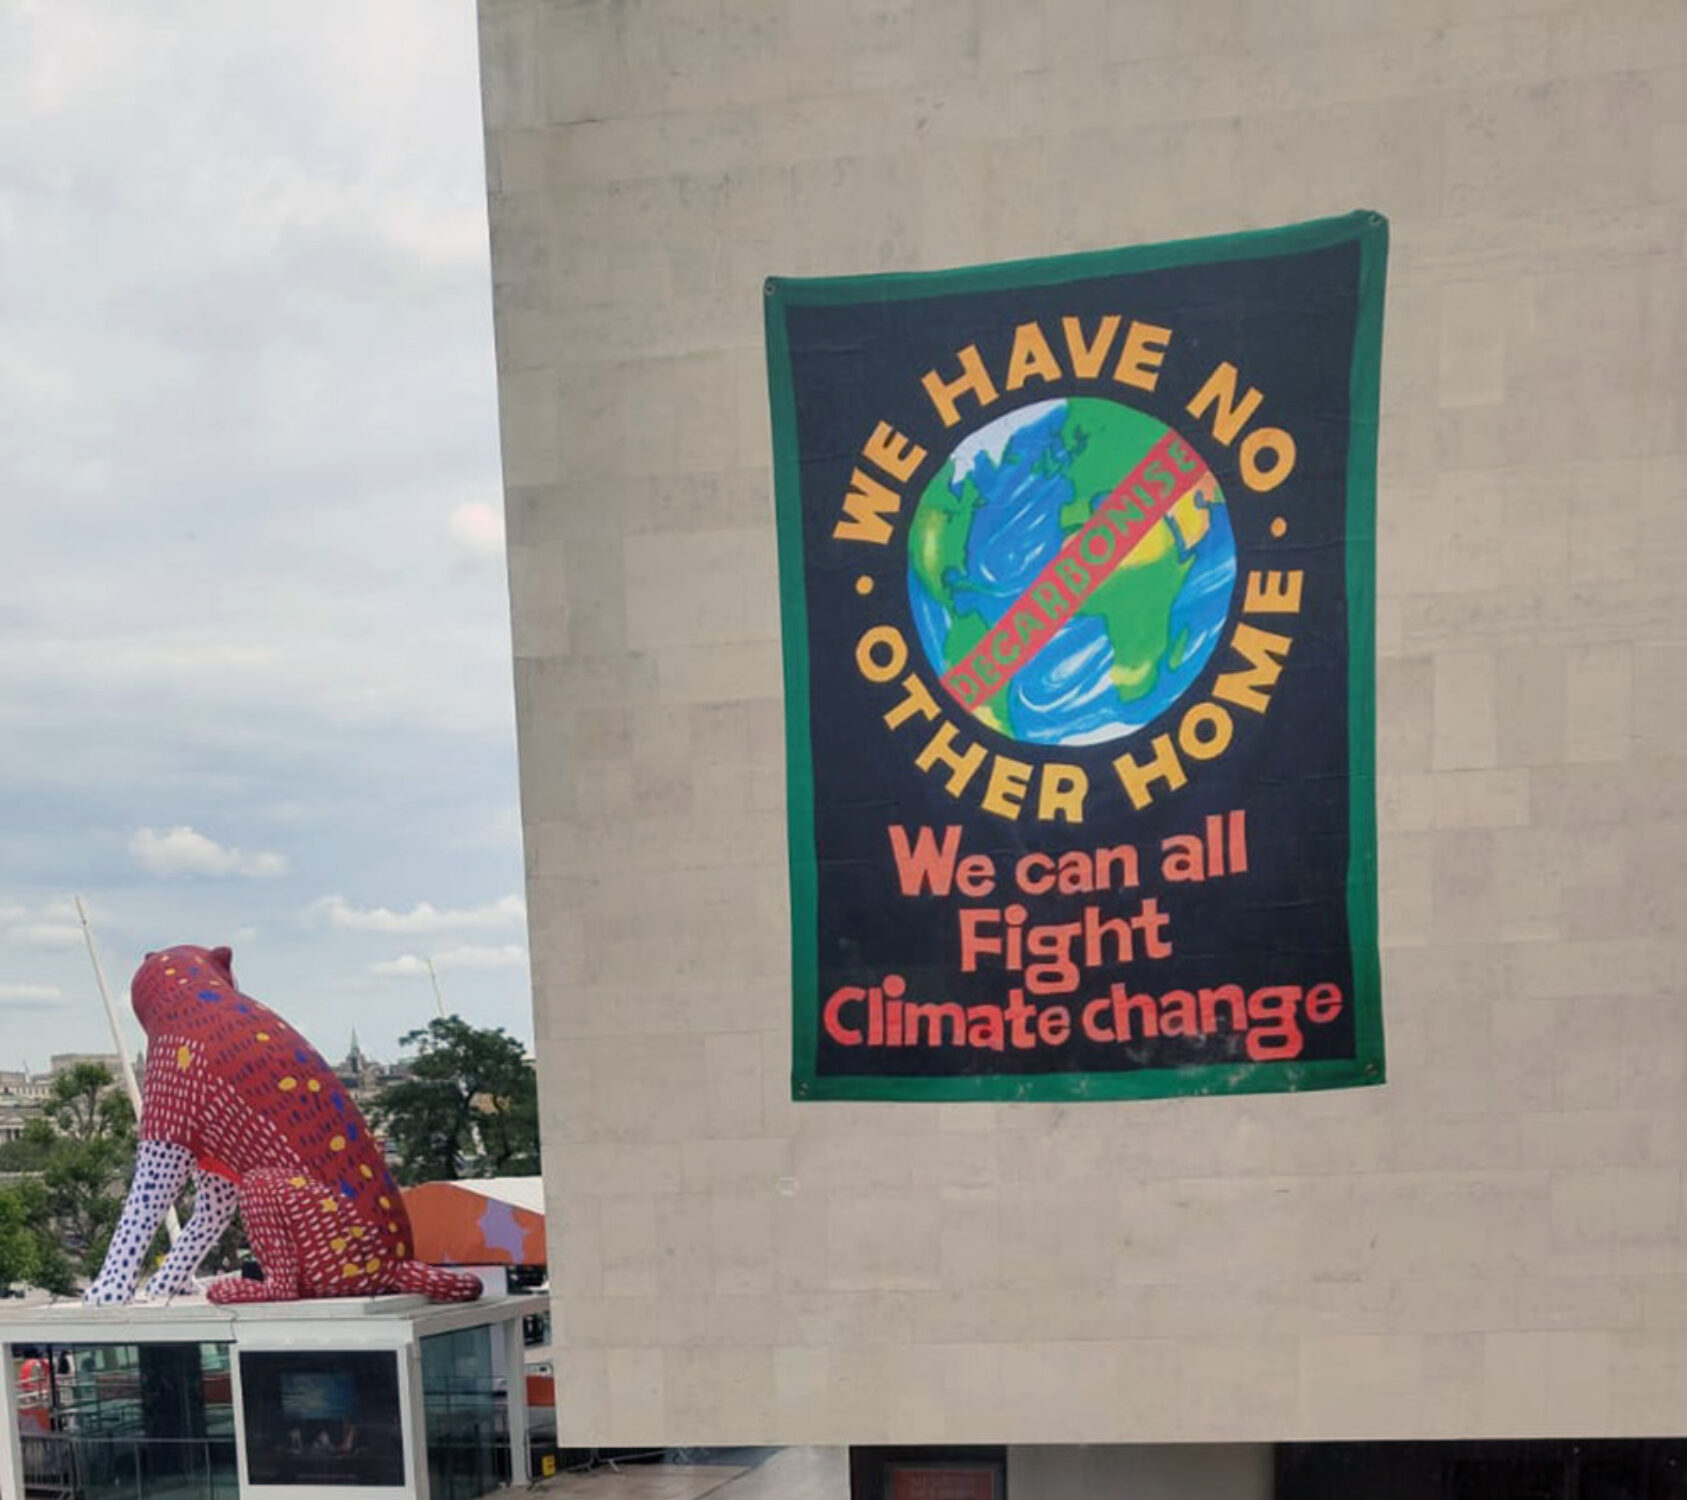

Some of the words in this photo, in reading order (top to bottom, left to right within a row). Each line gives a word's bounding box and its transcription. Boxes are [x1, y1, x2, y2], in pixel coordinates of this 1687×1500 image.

[833, 420, 928, 546] WE
[921, 314, 1173, 429] HAVE
[1185, 361, 1297, 492] NO
[948, 440, 1200, 706] DECARBONISE
[855, 625, 1090, 823] OTHER
[1112, 570, 1304, 811] HOME
[887, 824, 996, 898] We
[1014, 843, 1140, 896] can
[1160, 809, 1248, 884] all
[823, 974, 1072, 1052] Climate
[1081, 981, 1344, 1062] change
[958, 897, 1172, 995] Fight
